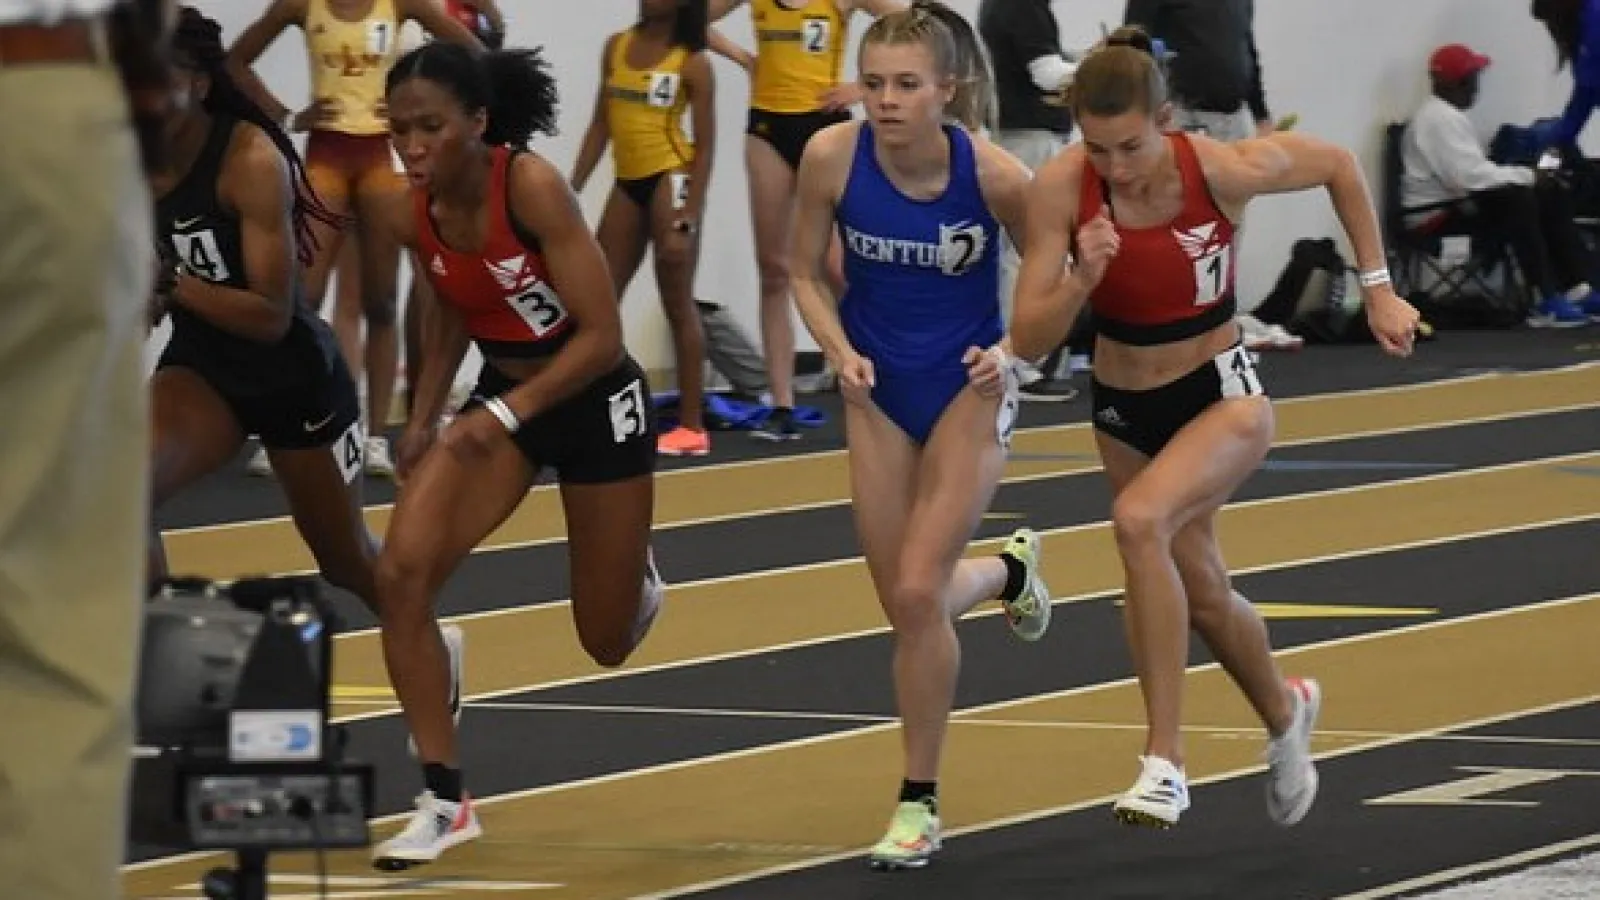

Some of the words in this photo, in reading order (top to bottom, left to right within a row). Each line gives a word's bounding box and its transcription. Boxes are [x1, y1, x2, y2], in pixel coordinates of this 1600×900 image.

[807, 22, 823, 52] 2
[654, 75, 672, 104] 4
[186, 236, 216, 277] 4
[1206, 255, 1222, 296] 1
[518, 291, 561, 328] 3
[619, 389, 641, 436] 3
